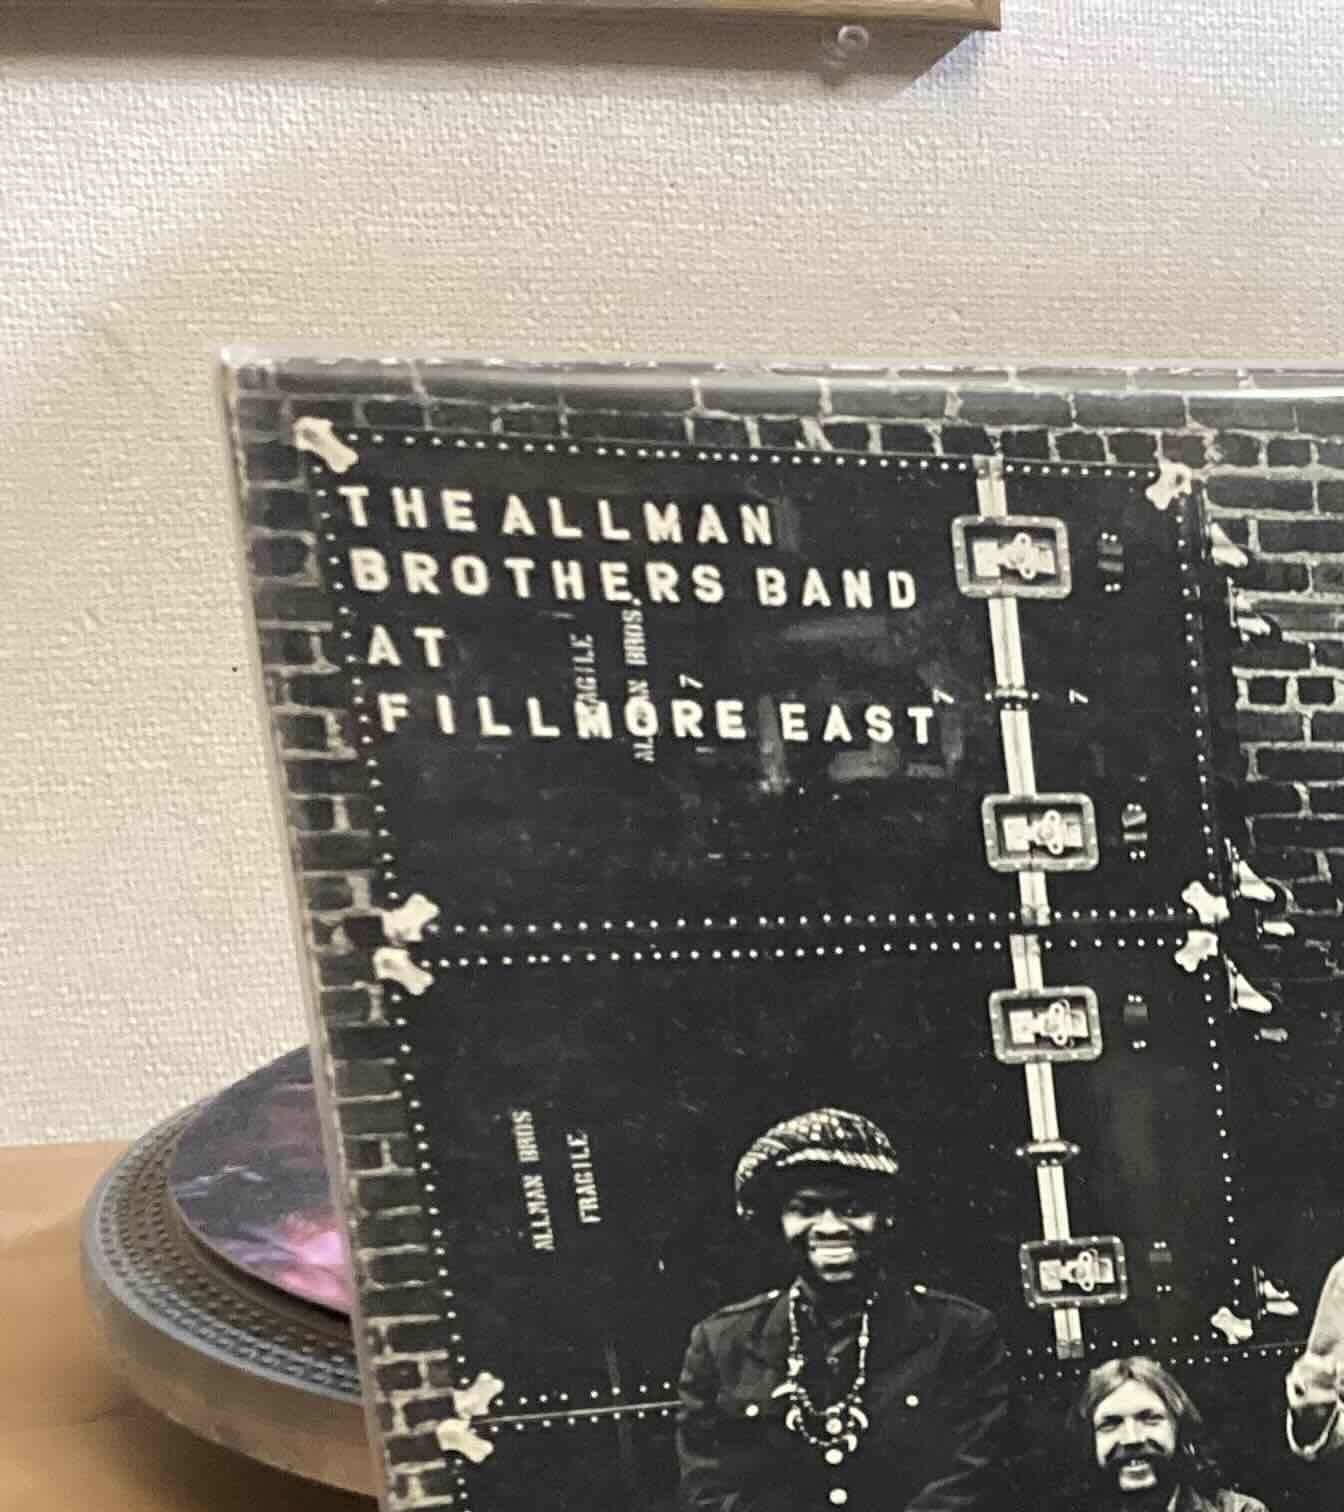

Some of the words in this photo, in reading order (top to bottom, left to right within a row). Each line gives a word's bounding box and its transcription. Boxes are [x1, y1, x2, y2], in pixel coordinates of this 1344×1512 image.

[338, 485, 477, 532] THE
[502, 495, 772, 545] ALLMAN
[350, 548, 724, 604] BROTHERS
[756, 567, 916, 609] BAND
[367, 625, 445, 667] AT
[379, 690, 747, 741] FILLMORE
[779, 702, 933, 745] EAST
[566, 1133, 601, 1224] FRAGILE
[519, 1174, 555, 1251] ALLMAN
